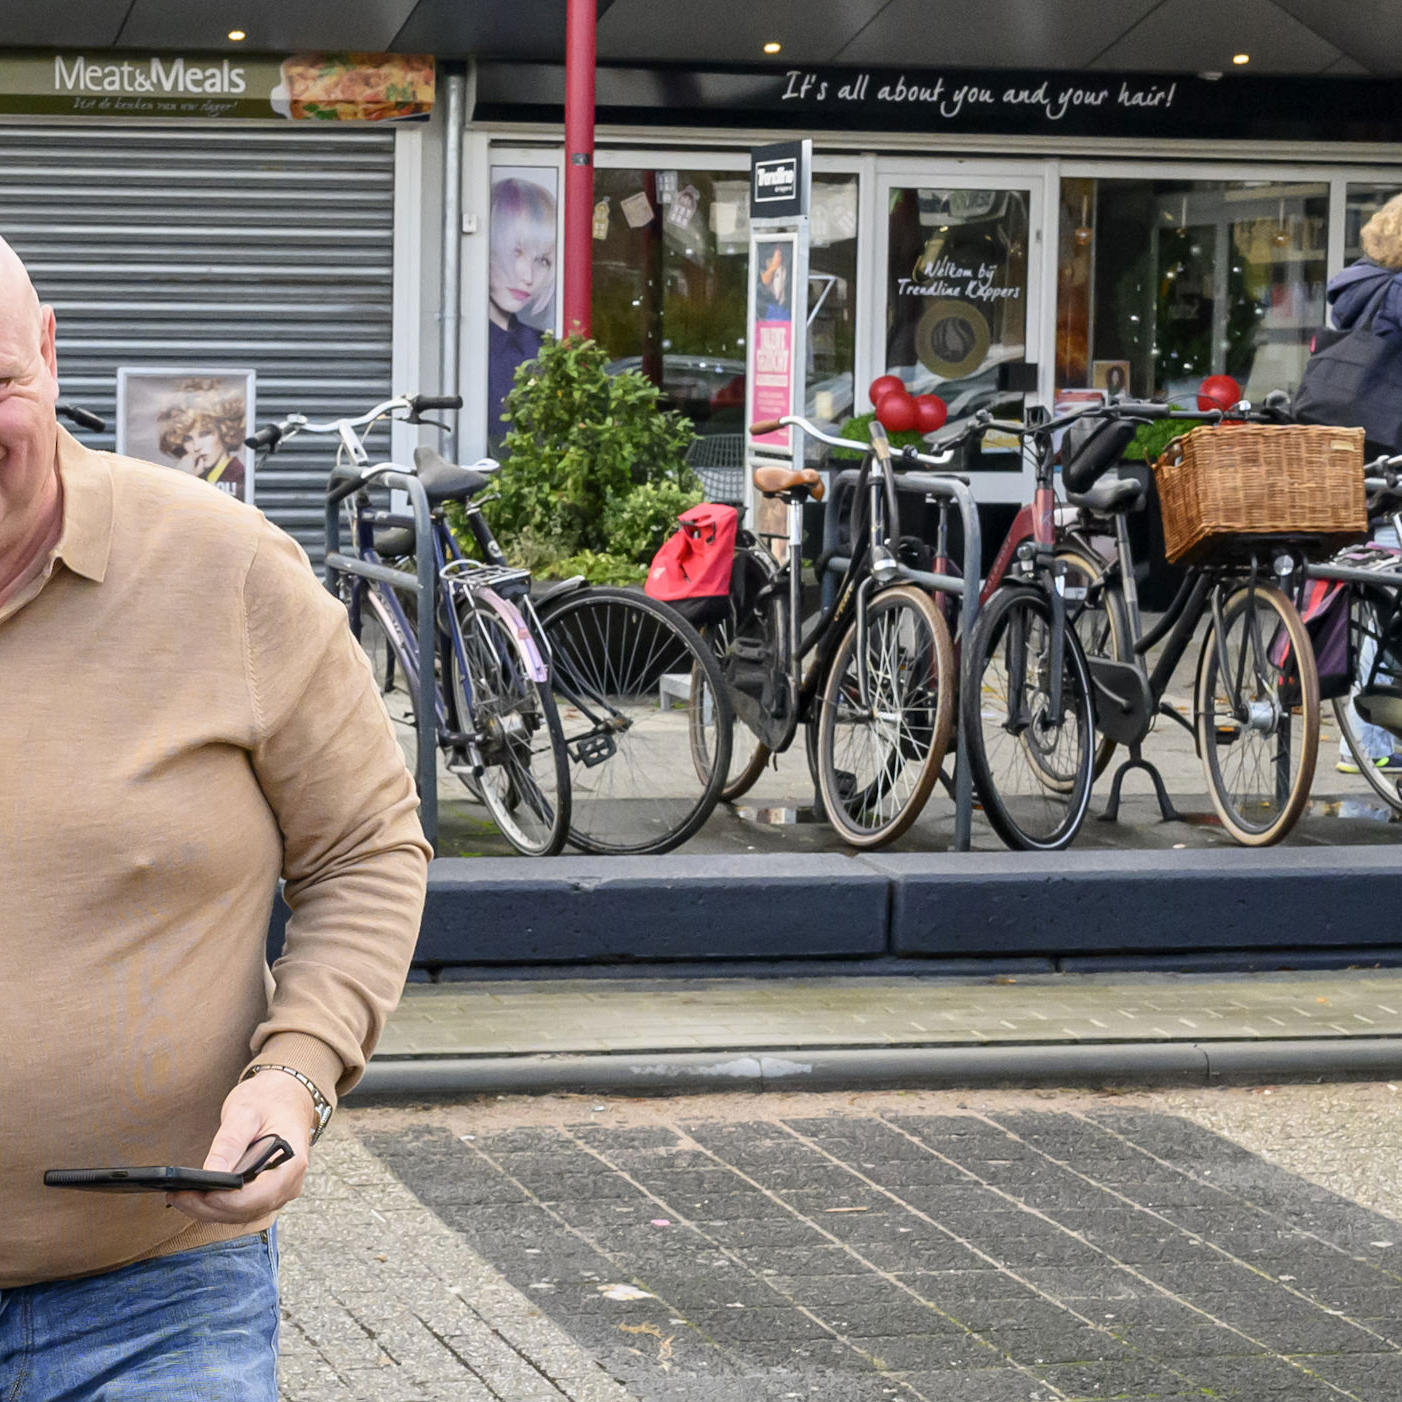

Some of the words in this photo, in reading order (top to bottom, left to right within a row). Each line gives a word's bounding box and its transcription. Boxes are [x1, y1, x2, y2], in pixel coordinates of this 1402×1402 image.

[54, 55, 246, 94] Meat&Meals
[781, 70, 828, 100] It's
[837, 74, 868, 100] all
[877, 76, 944, 102] about
[940, 84, 995, 118] you
[1002, 81, 1049, 104] and
[1045, 88, 1109, 120] your
[1116, 81, 1177, 108] hair!
[924, 255, 973, 278] Welkom
[897, 279, 960, 296] Trendline
